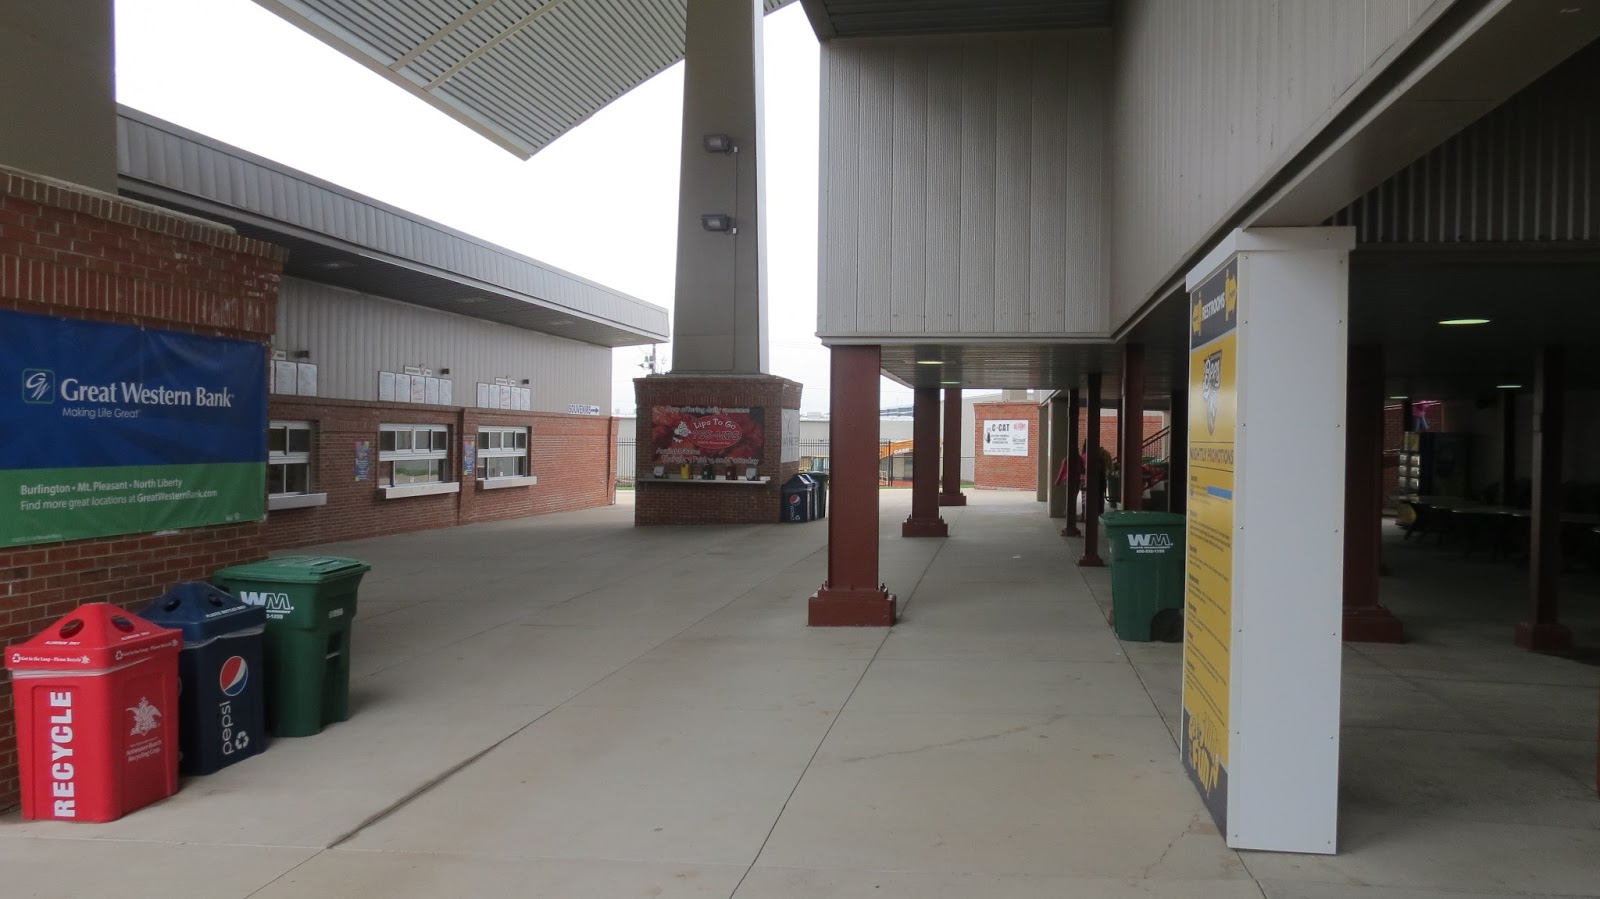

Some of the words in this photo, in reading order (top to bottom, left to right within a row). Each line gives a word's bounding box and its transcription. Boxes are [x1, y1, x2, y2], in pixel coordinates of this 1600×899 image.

[1202, 292, 1225, 320] RESTROOMS
[61, 378, 117, 403] Great
[121, 382, 191, 406] Western
[196, 387, 232, 408] Bank
[62, 407, 96, 420] Making
[98, 408, 112, 418] Life
[114, 408, 139, 419] Great
[569, 404, 591, 415] SOUVENIRS
[693, 420, 711, 430] Lips
[713, 418, 723, 426] To
[725, 421, 737, 430] Go
[21, 484, 70, 496] Burlington
[77, 482, 92, 491] Mt.
[93, 481, 128, 491] Pleasant
[133, 479, 156, 488] North
[157, 478, 182, 488] Liberty
[21, 500, 41, 511] Find
[43, 500, 67, 509] more
[69, 497, 89, 510] great
[91, 496, 127, 506] locations
[128, 495, 136, 503] at
[137, 490, 218, 503] GreatWesternBank.com
[219, 700, 234, 755] pepsi
[50, 691, 76, 818] RECYCLE
